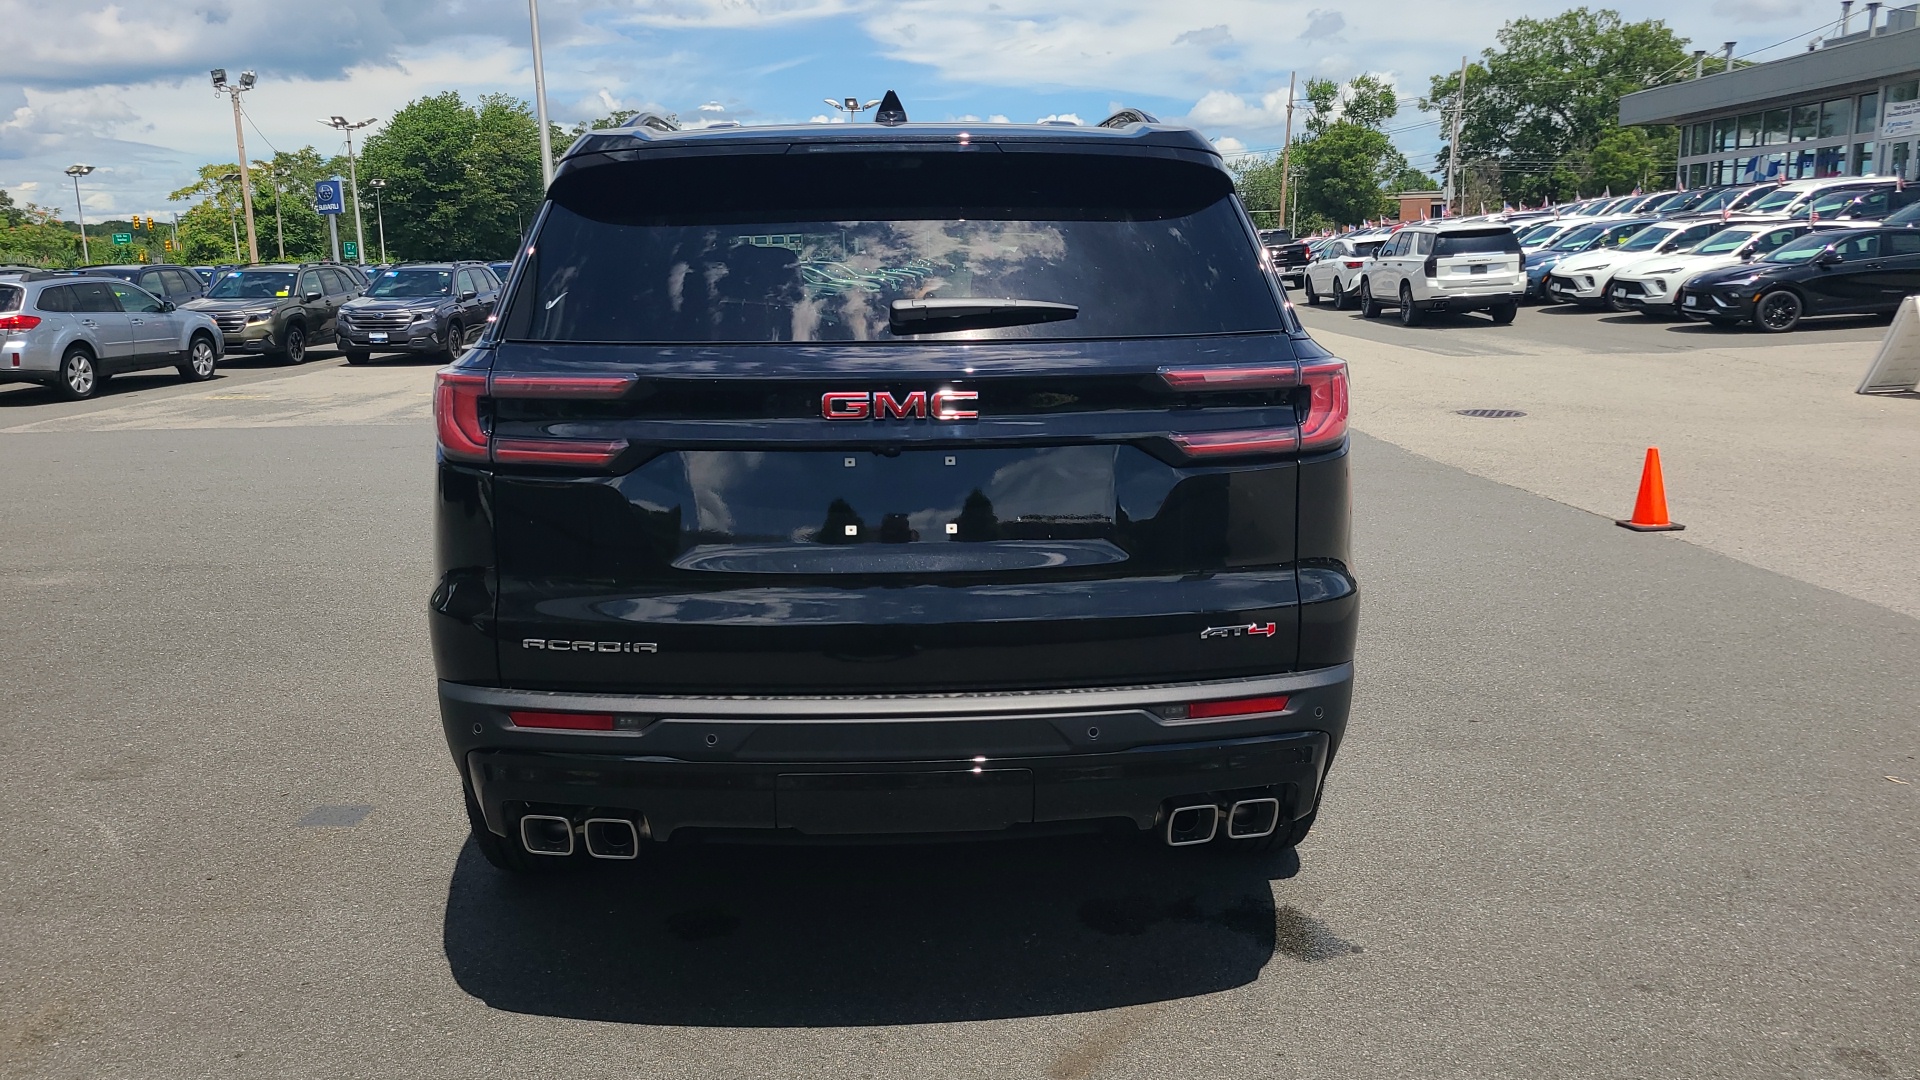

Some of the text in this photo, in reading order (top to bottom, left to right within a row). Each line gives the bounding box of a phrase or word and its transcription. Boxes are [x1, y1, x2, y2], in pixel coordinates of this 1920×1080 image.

[318, 203, 340, 211] SUBARU
[821, 390, 979, 420] GMC
[1200, 622, 1276, 639] AT4
[522, 638, 658, 653] ACADIA
